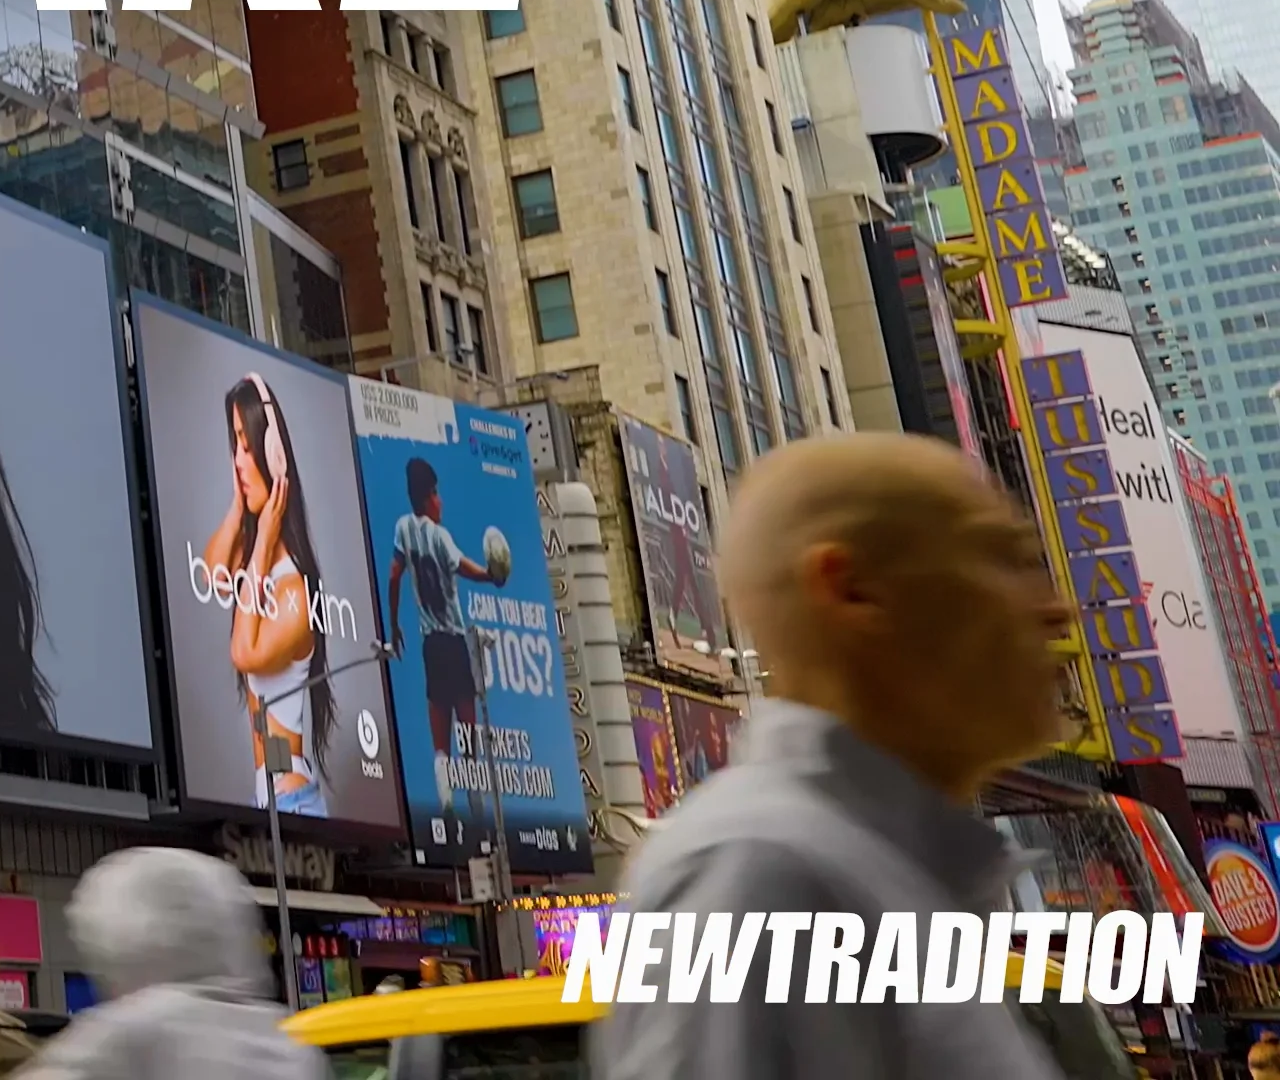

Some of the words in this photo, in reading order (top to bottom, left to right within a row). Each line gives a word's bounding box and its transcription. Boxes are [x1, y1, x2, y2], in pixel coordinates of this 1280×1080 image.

[950, 30, 1051, 304] MADAME
[646, 484, 700, 532] ALDO
[1032, 355, 1164, 758] TUSSAUDS
[187, 541, 279, 621] beats
[286, 588, 299, 614] x
[304, 575, 357, 641] kim
[498, 597, 520, 626] YOU
[521, 601, 547, 632] BEAT
[475, 724, 532, 761] TCKETS
[361, 759, 383, 779] beats
[1211, 870, 1249, 906] DAVE
[1248, 867, 1266, 895] &
